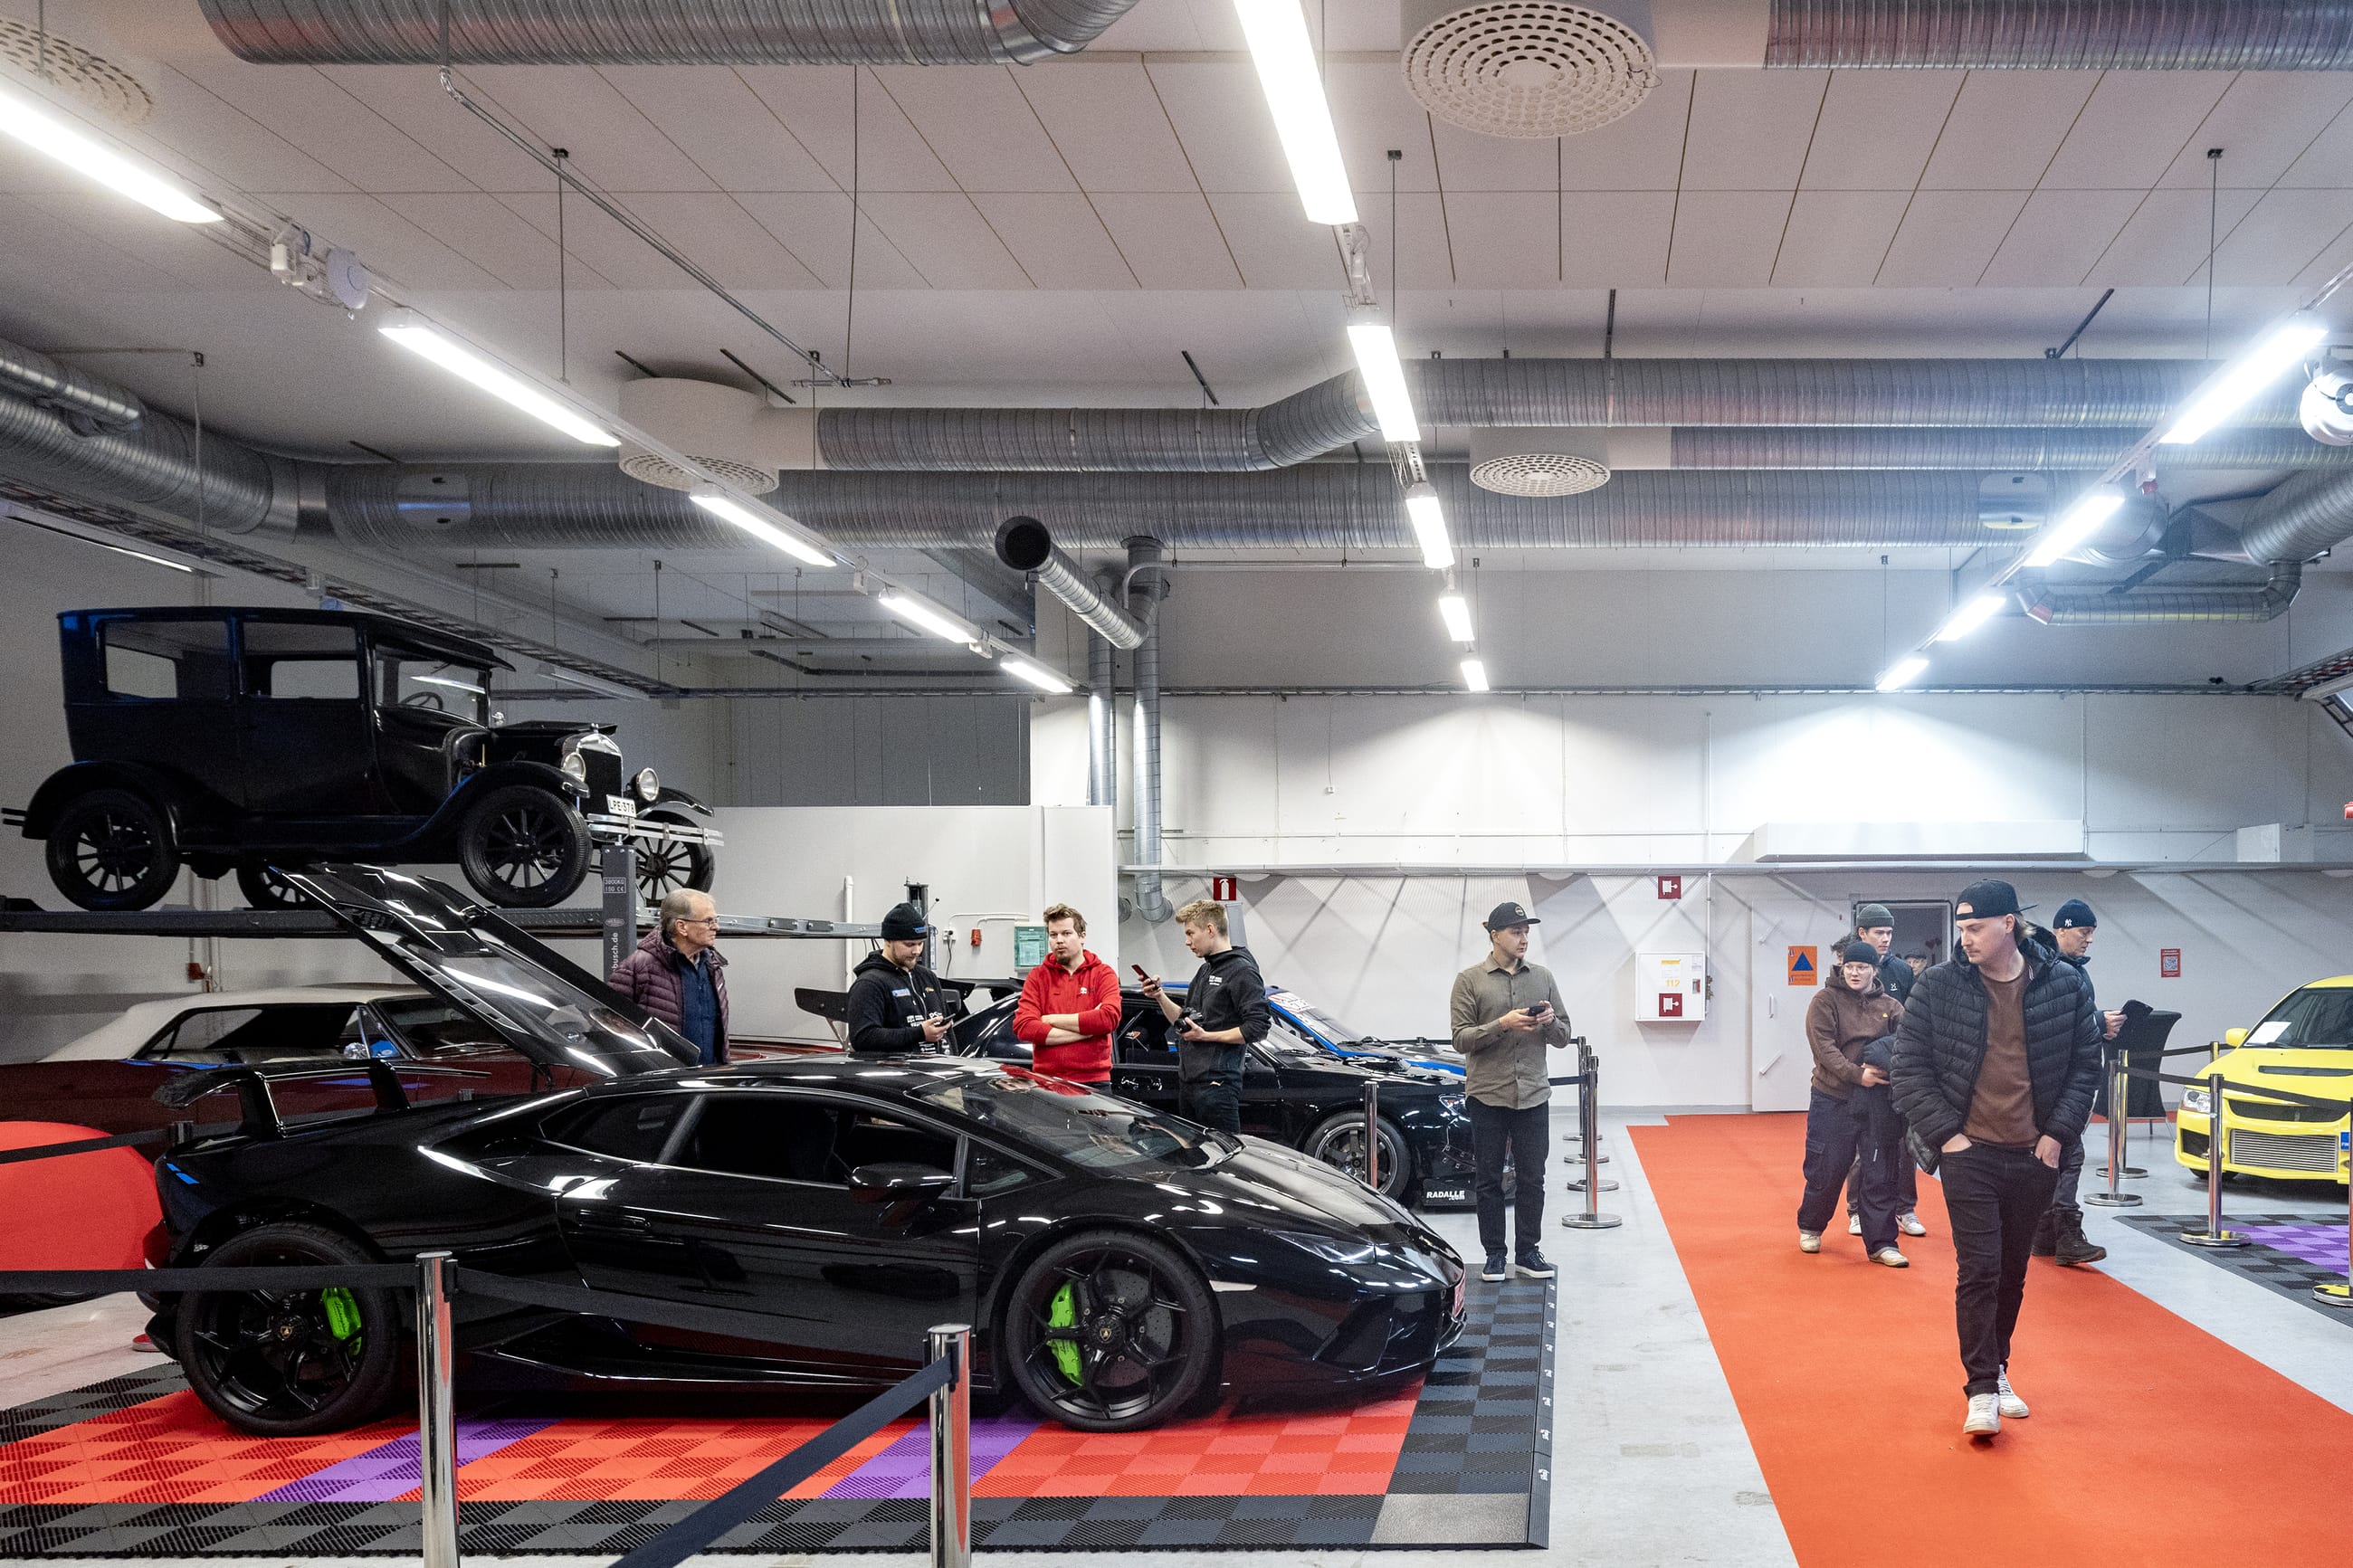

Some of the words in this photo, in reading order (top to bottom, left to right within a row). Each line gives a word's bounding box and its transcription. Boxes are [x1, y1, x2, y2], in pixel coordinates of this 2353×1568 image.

[611, 932, 619, 972] busch.de
[1666, 979, 1681, 987] 112
[1426, 1190, 1465, 1198] RADALLE
